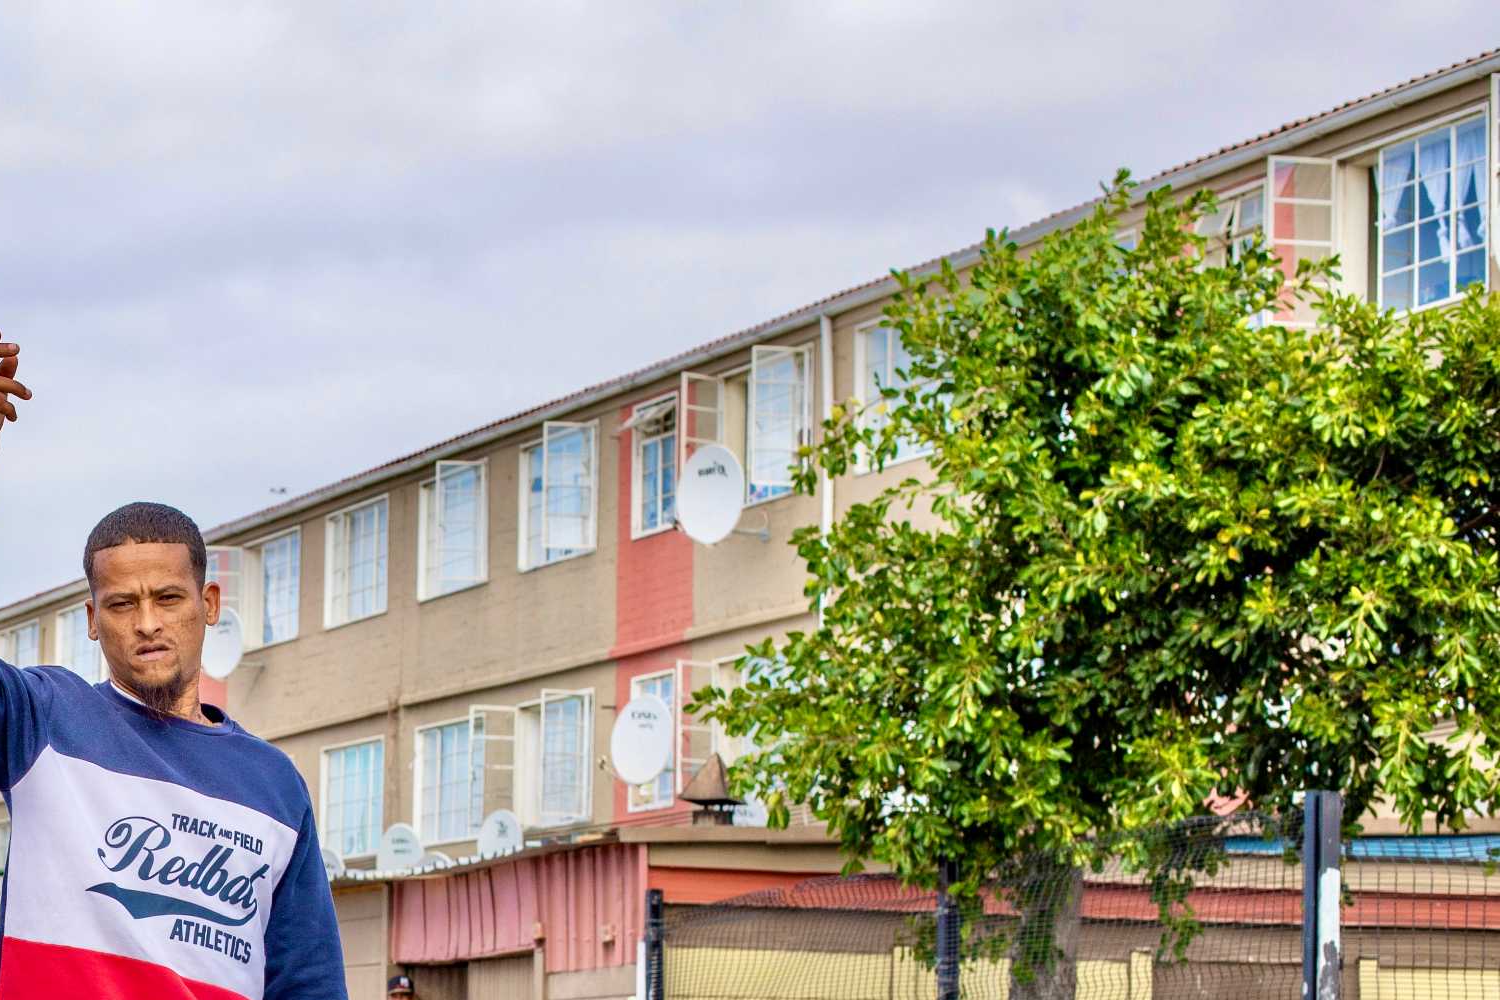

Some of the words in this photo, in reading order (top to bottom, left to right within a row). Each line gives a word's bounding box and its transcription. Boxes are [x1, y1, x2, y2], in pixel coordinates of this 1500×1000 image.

[171, 813, 217, 839] TRACK
[218, 828, 233, 840] AND
[233, 830, 263, 856] FIELD
[97, 815, 270, 910] Redbat
[169, 918, 252, 965] ATHLETICS
